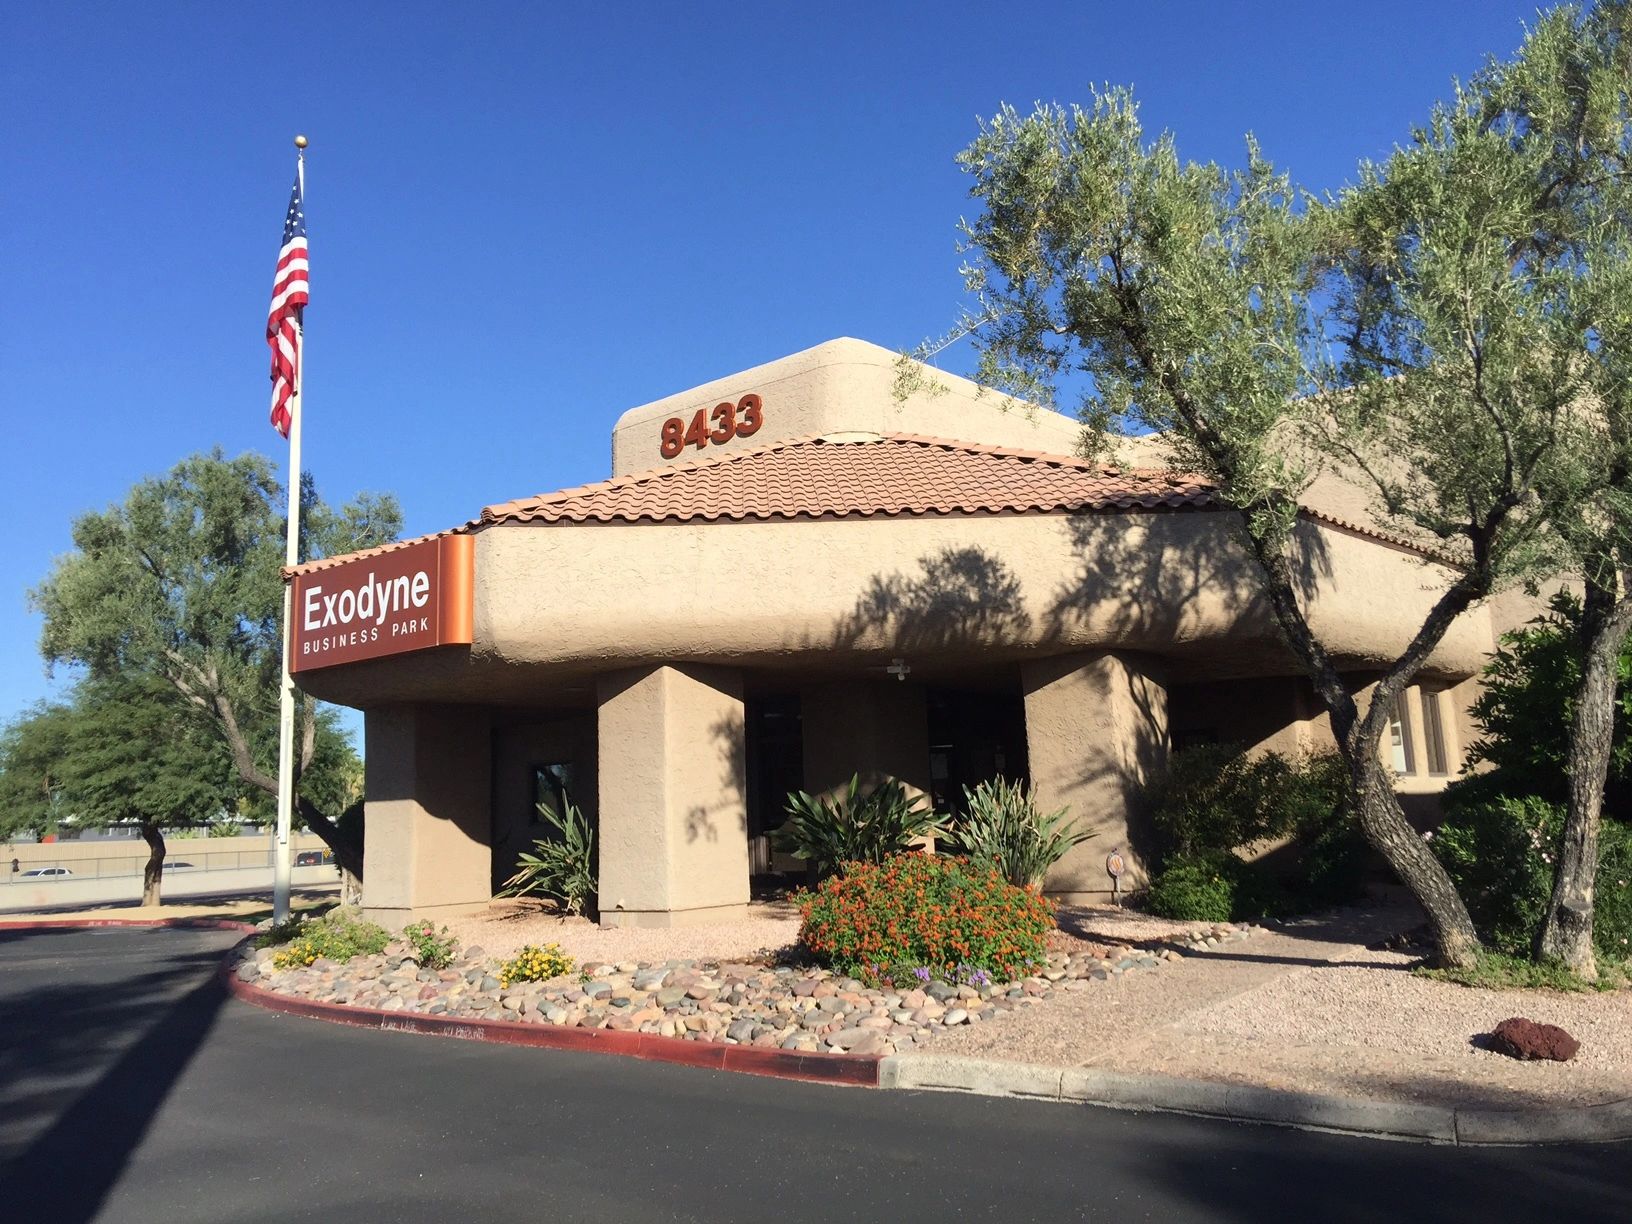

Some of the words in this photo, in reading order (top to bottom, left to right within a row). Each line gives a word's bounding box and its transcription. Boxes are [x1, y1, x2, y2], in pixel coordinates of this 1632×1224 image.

[660, 393, 763, 460] 8433
[304, 571, 430, 631] Exodyne
[303, 627, 378, 655] BUSINESS
[392, 617, 428, 637] PARK
